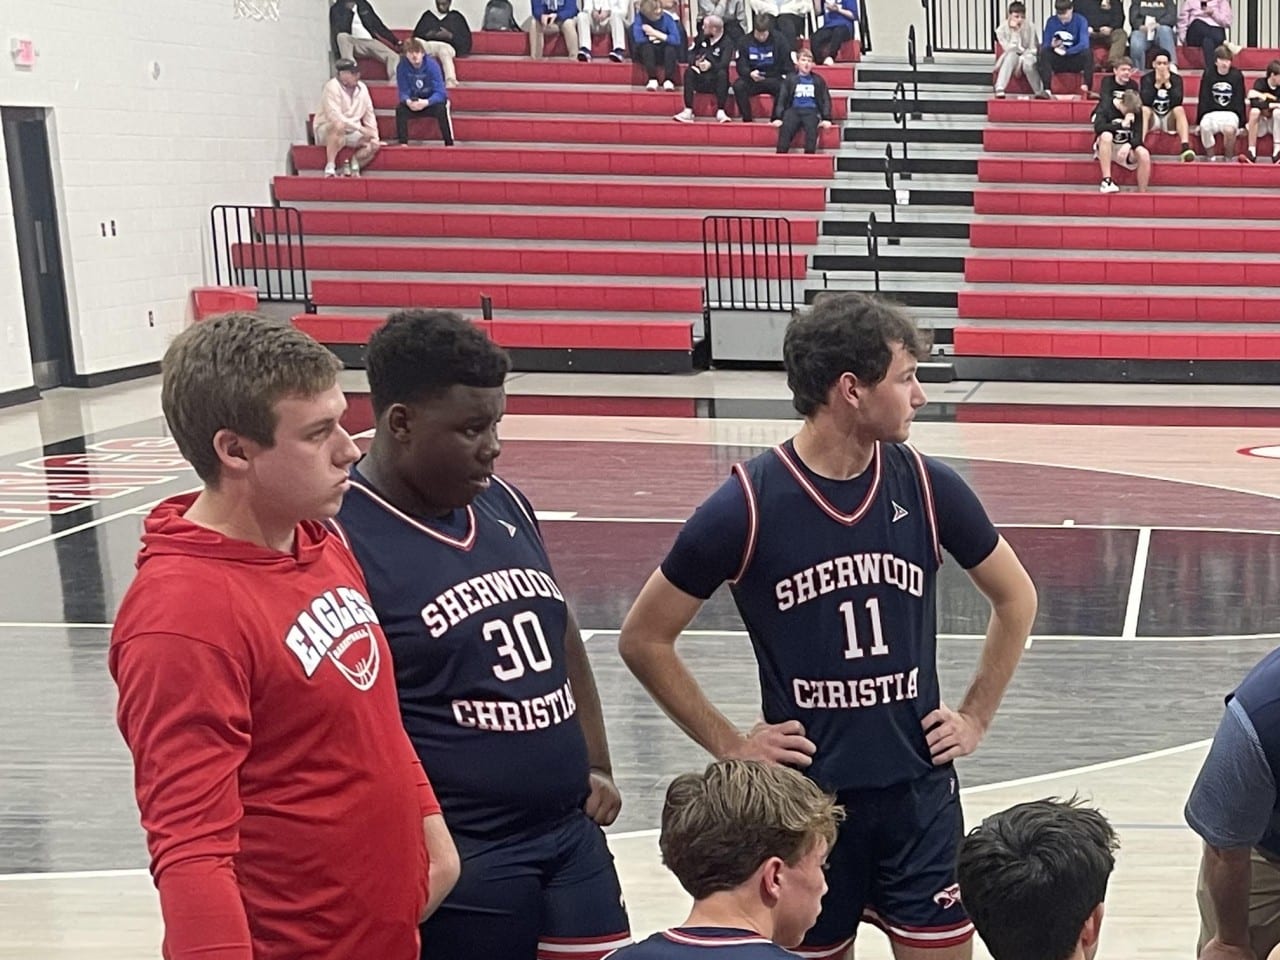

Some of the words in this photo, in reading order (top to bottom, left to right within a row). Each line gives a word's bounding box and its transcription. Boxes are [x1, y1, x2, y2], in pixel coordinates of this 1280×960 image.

[421, 568, 566, 638] SHERWOOD
[775, 553, 924, 612] SHERWOOD
[285, 587, 379, 678] EAGLES
[482, 610, 552, 682] 30
[839, 597, 889, 660] 11
[451, 677, 577, 732] CHRISTIA
[792, 666, 919, 709] CHRISTIA
